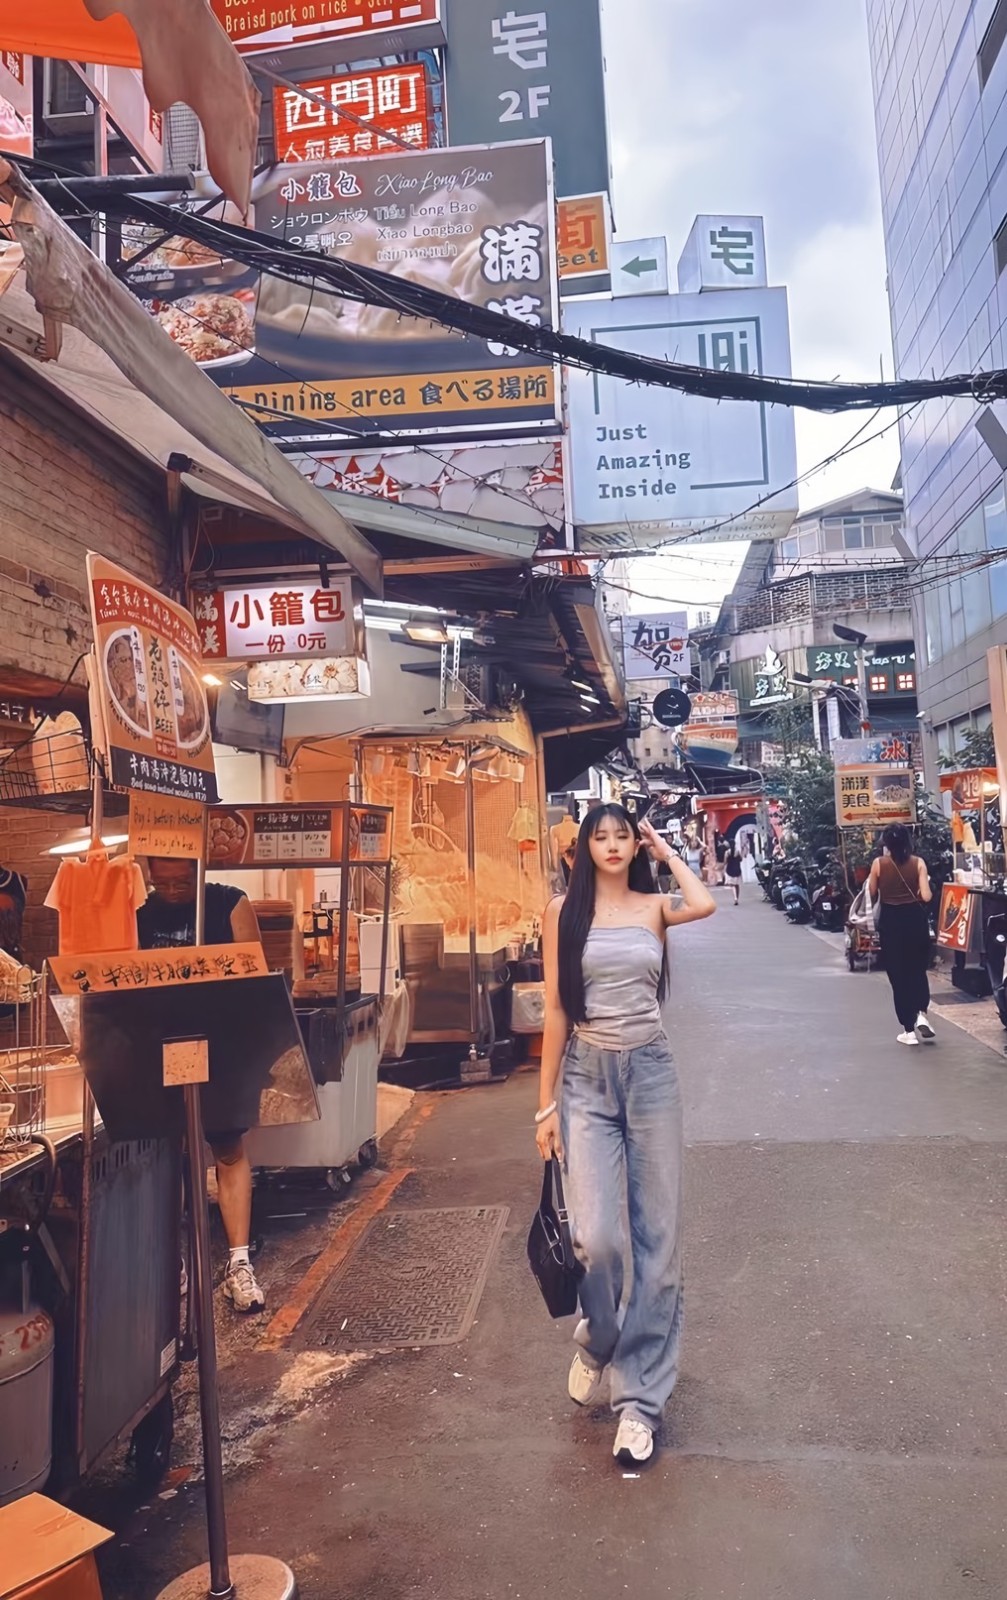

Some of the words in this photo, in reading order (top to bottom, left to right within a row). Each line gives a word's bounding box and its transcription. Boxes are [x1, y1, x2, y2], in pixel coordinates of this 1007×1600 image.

[226, 11, 266, 33] Braisd
[270, 7, 297, 29] pork
[302, 7, 316, 20] on
[320, 1, 348, 17] rice
[283, 72, 421, 133] 西門町
[498, 85, 551, 123] 2F
[281, 171, 362, 202] 小籠包
[374, 172, 418, 197] Xiao
[418, 169, 459, 194] Long
[461, 166, 494, 189] Bao
[410, 204, 445, 219] Long
[450, 201, 478, 214] Bao
[376, 227, 408, 241] Xiao
[413, 223, 473, 238] Longbao
[351, 387, 406, 408] area
[418, 374, 547, 406] 食べる場所
[596, 424, 648, 442] Just
[596, 449, 691, 471] Amazing
[598, 478, 677, 499] Inside
[229, 589, 346, 630] 小籠包
[244, 635, 286, 654] 一份
[673, 653, 685, 663] 2F
[842, 793, 871, 809] 美食
